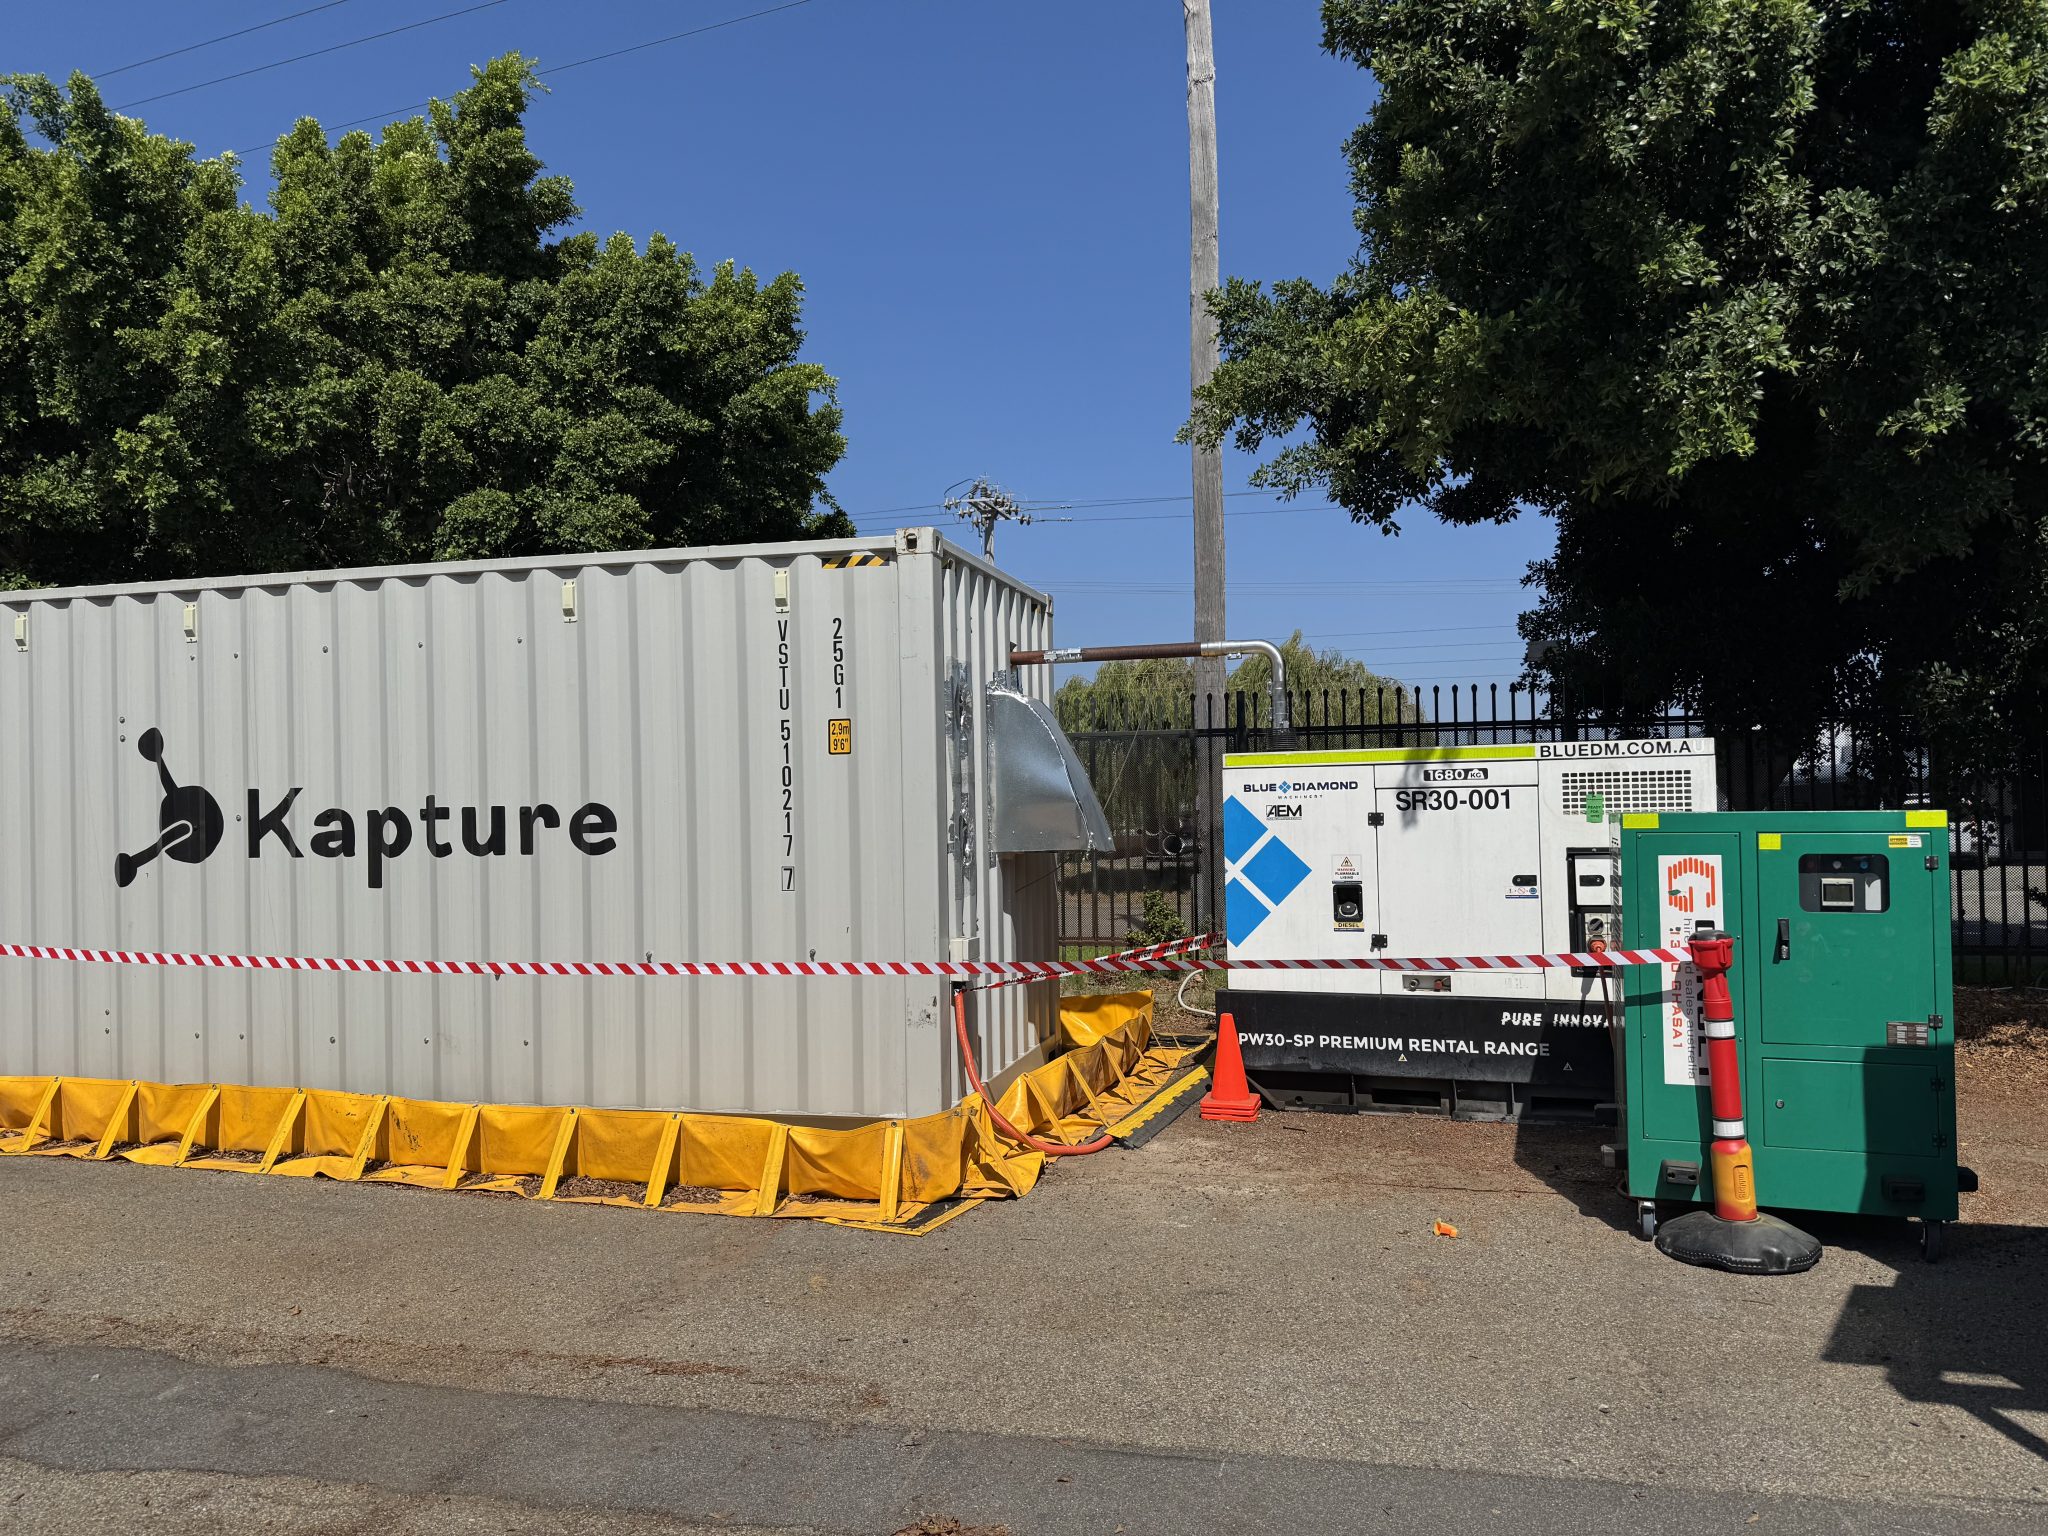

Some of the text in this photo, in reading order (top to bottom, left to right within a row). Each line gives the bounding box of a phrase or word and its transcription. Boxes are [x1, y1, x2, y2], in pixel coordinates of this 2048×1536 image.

[777, 619, 790, 711] VSTU
[832, 617, 844, 709] 25G1
[780, 719, 793, 857] 510217
[1243, 781, 1358, 793] BLUE DIAMOND
[1428, 769, 1465, 781] 1680
[1266, 804, 1302, 818] AEM
[1395, 789, 1511, 811] SR30-001
[247, 787, 618, 889] Kapture
[1683, 918, 1693, 944] hire
[1685, 979, 1695, 1016] sales
[1501, 1012, 1542, 1026] PURE
[1671, 981, 1683, 1048] GHASA1
[1238, 1032, 1550, 1056] PW30-SP PREMIUM RENTAL RANGE
[1686, 1020, 1698, 1080] australia
